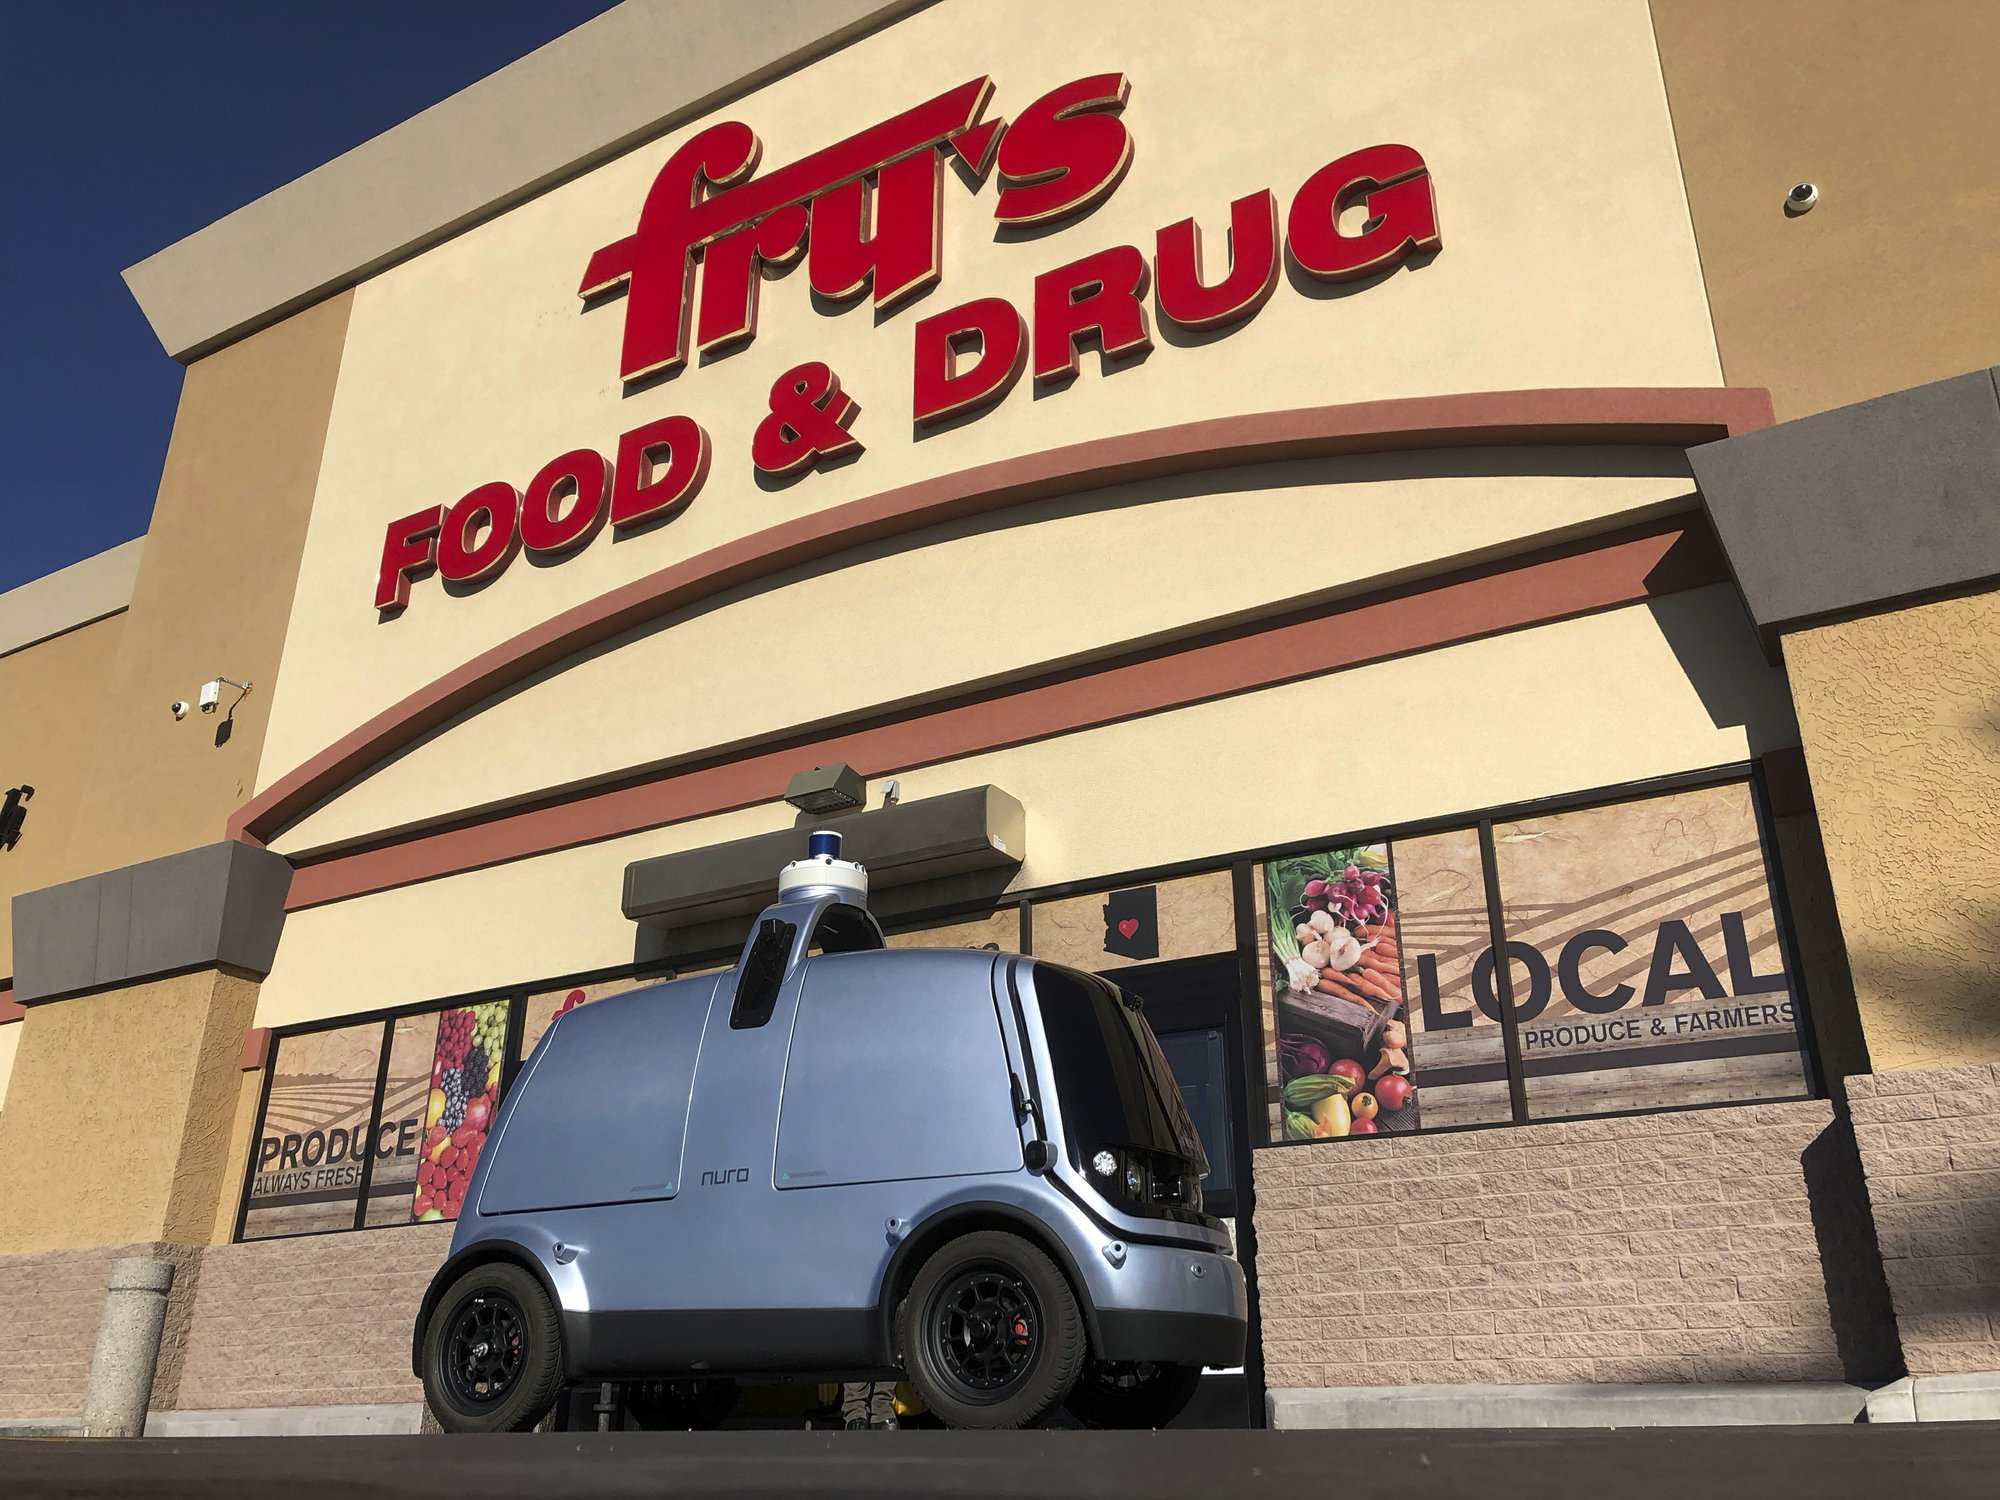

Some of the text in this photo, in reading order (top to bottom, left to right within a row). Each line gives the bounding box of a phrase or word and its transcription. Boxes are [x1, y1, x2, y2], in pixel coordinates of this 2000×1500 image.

[374, 143, 1443, 614] FOOD & DRUG
[1416, 911, 1790, 1032] LOCAL
[1525, 1002, 1796, 1050] PRODUCE & FARMERS
[257, 1118, 419, 1173] PRODUCE
[253, 1170, 312, 1196] ALWAYS
[701, 1167, 750, 1186] nuro
